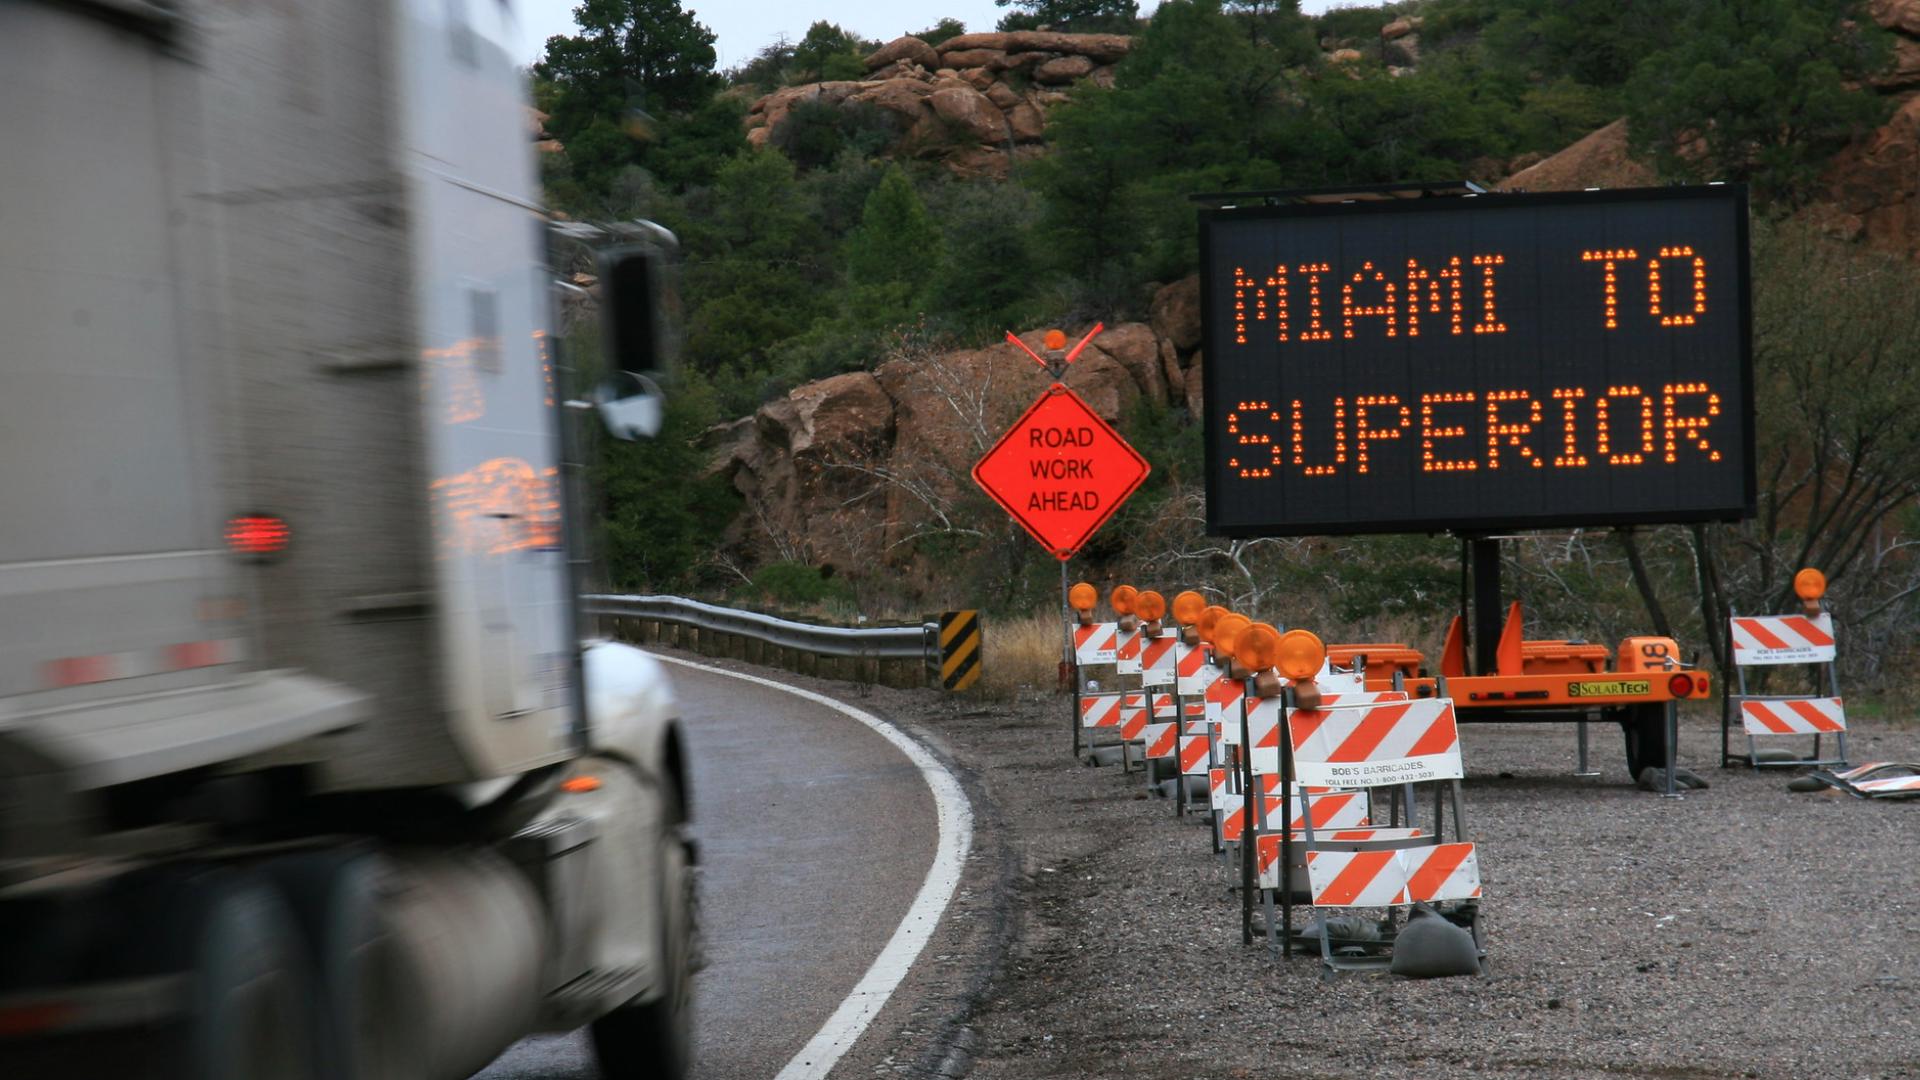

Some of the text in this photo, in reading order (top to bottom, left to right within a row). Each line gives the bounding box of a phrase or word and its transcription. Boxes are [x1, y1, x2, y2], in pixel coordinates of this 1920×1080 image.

[1235, 246, 1706, 344] MIAMI TO
[1030, 427, 1094, 448] ROAD
[1228, 383, 1721, 478] SUPERIOR
[1030, 459, 1094, 480] WORK
[1028, 491, 1099, 511] AHEAD
[1331, 767, 1360, 776] BOB'S
